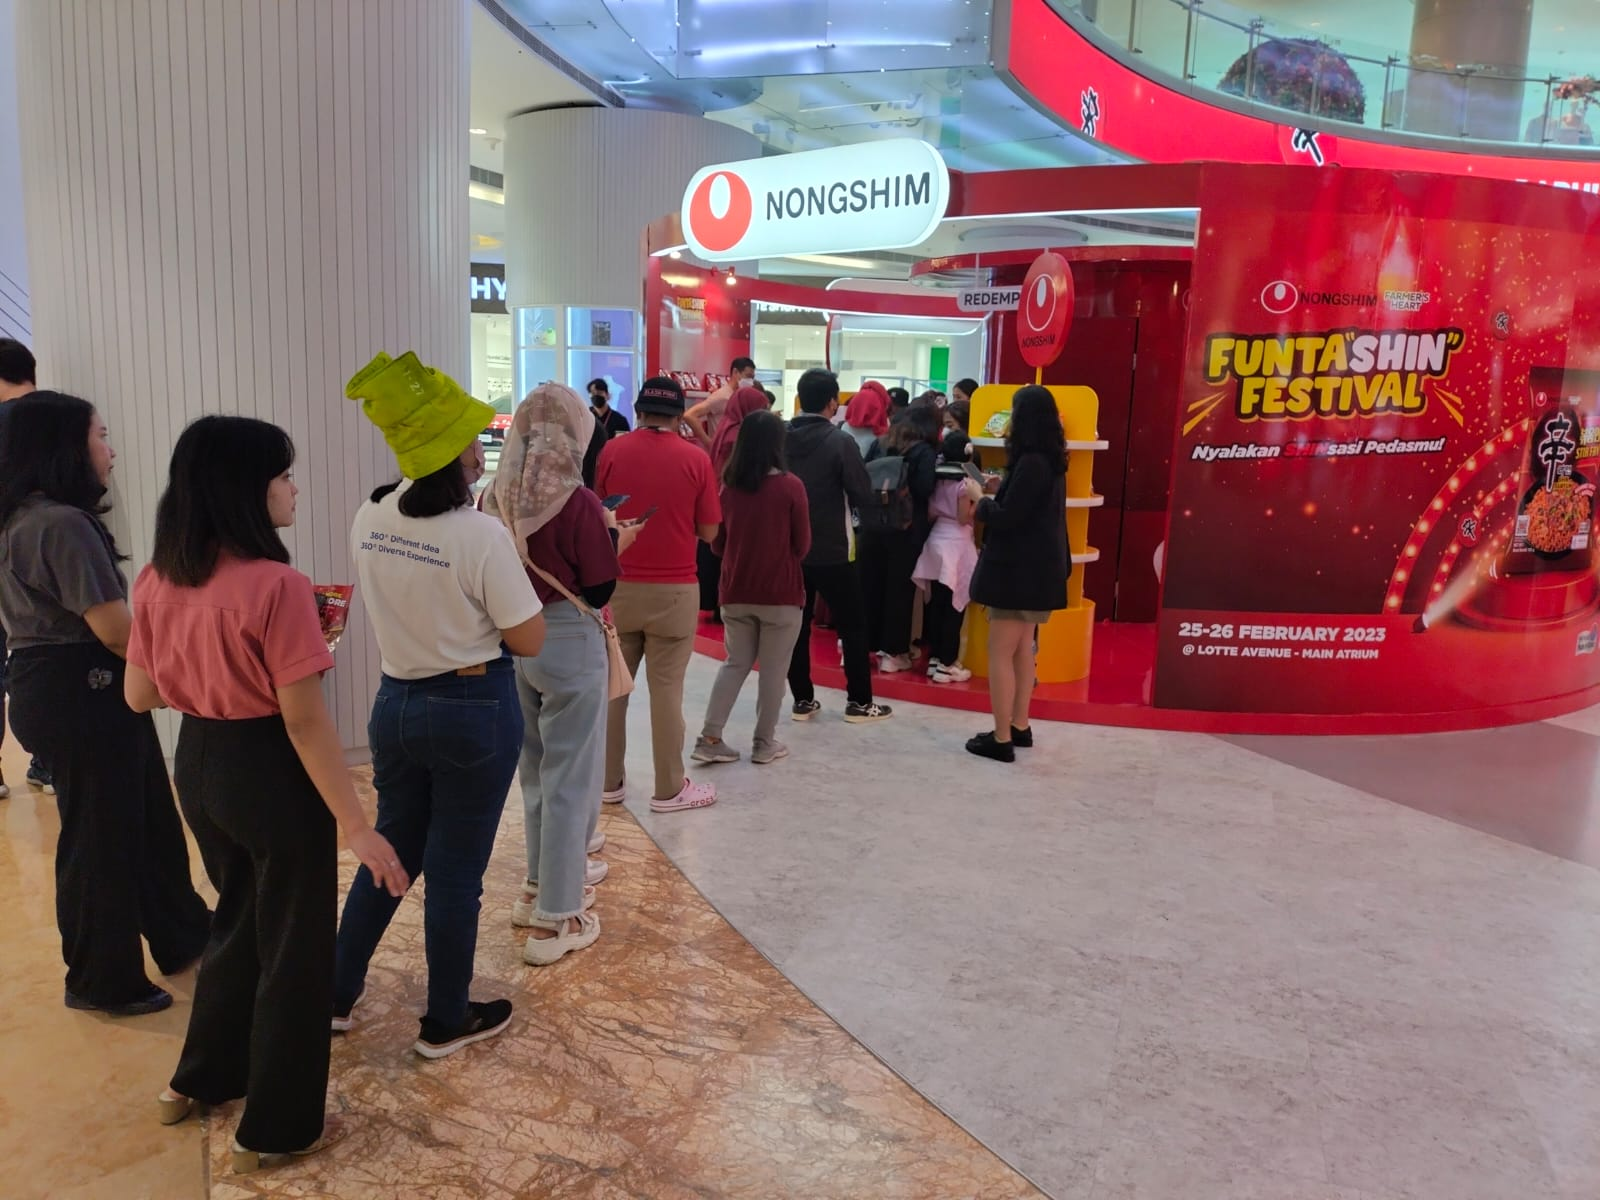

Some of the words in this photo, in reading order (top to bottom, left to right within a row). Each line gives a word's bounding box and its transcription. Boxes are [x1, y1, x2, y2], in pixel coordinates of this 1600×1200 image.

[766, 171, 931, 221] NONGSHIM
[1300, 292, 1378, 307] NONGSHIM
[1384, 290, 1430, 302] FARMER'S
[1391, 301, 1421, 312] HEART
[1022, 333, 1056, 348] NONGSHIM
[1240, 372, 1422, 414] FESTIVAL
[1192, 444, 1280, 461] Nyalakan
[1364, 437, 1446, 454] Pedasmu!
[370, 531, 389, 541] 360°
[390, 535, 420, 549] Different
[422, 543, 440, 554] Idea
[378, 544, 406, 557] Diverse
[407, 550, 450, 568] Experience
[1178, 622, 1234, 639] 25-26
[1239, 624, 1340, 642] FEBRUARY
[1343, 627, 1386, 642] 2023
[1182, 644, 1195, 656] @
[1198, 645, 1238, 657] LOTTE
[1241, 647, 1292, 658] AVENUE
[1302, 648, 1333, 659] MAIN
[1335, 649, 1379, 660] ATRIUM
